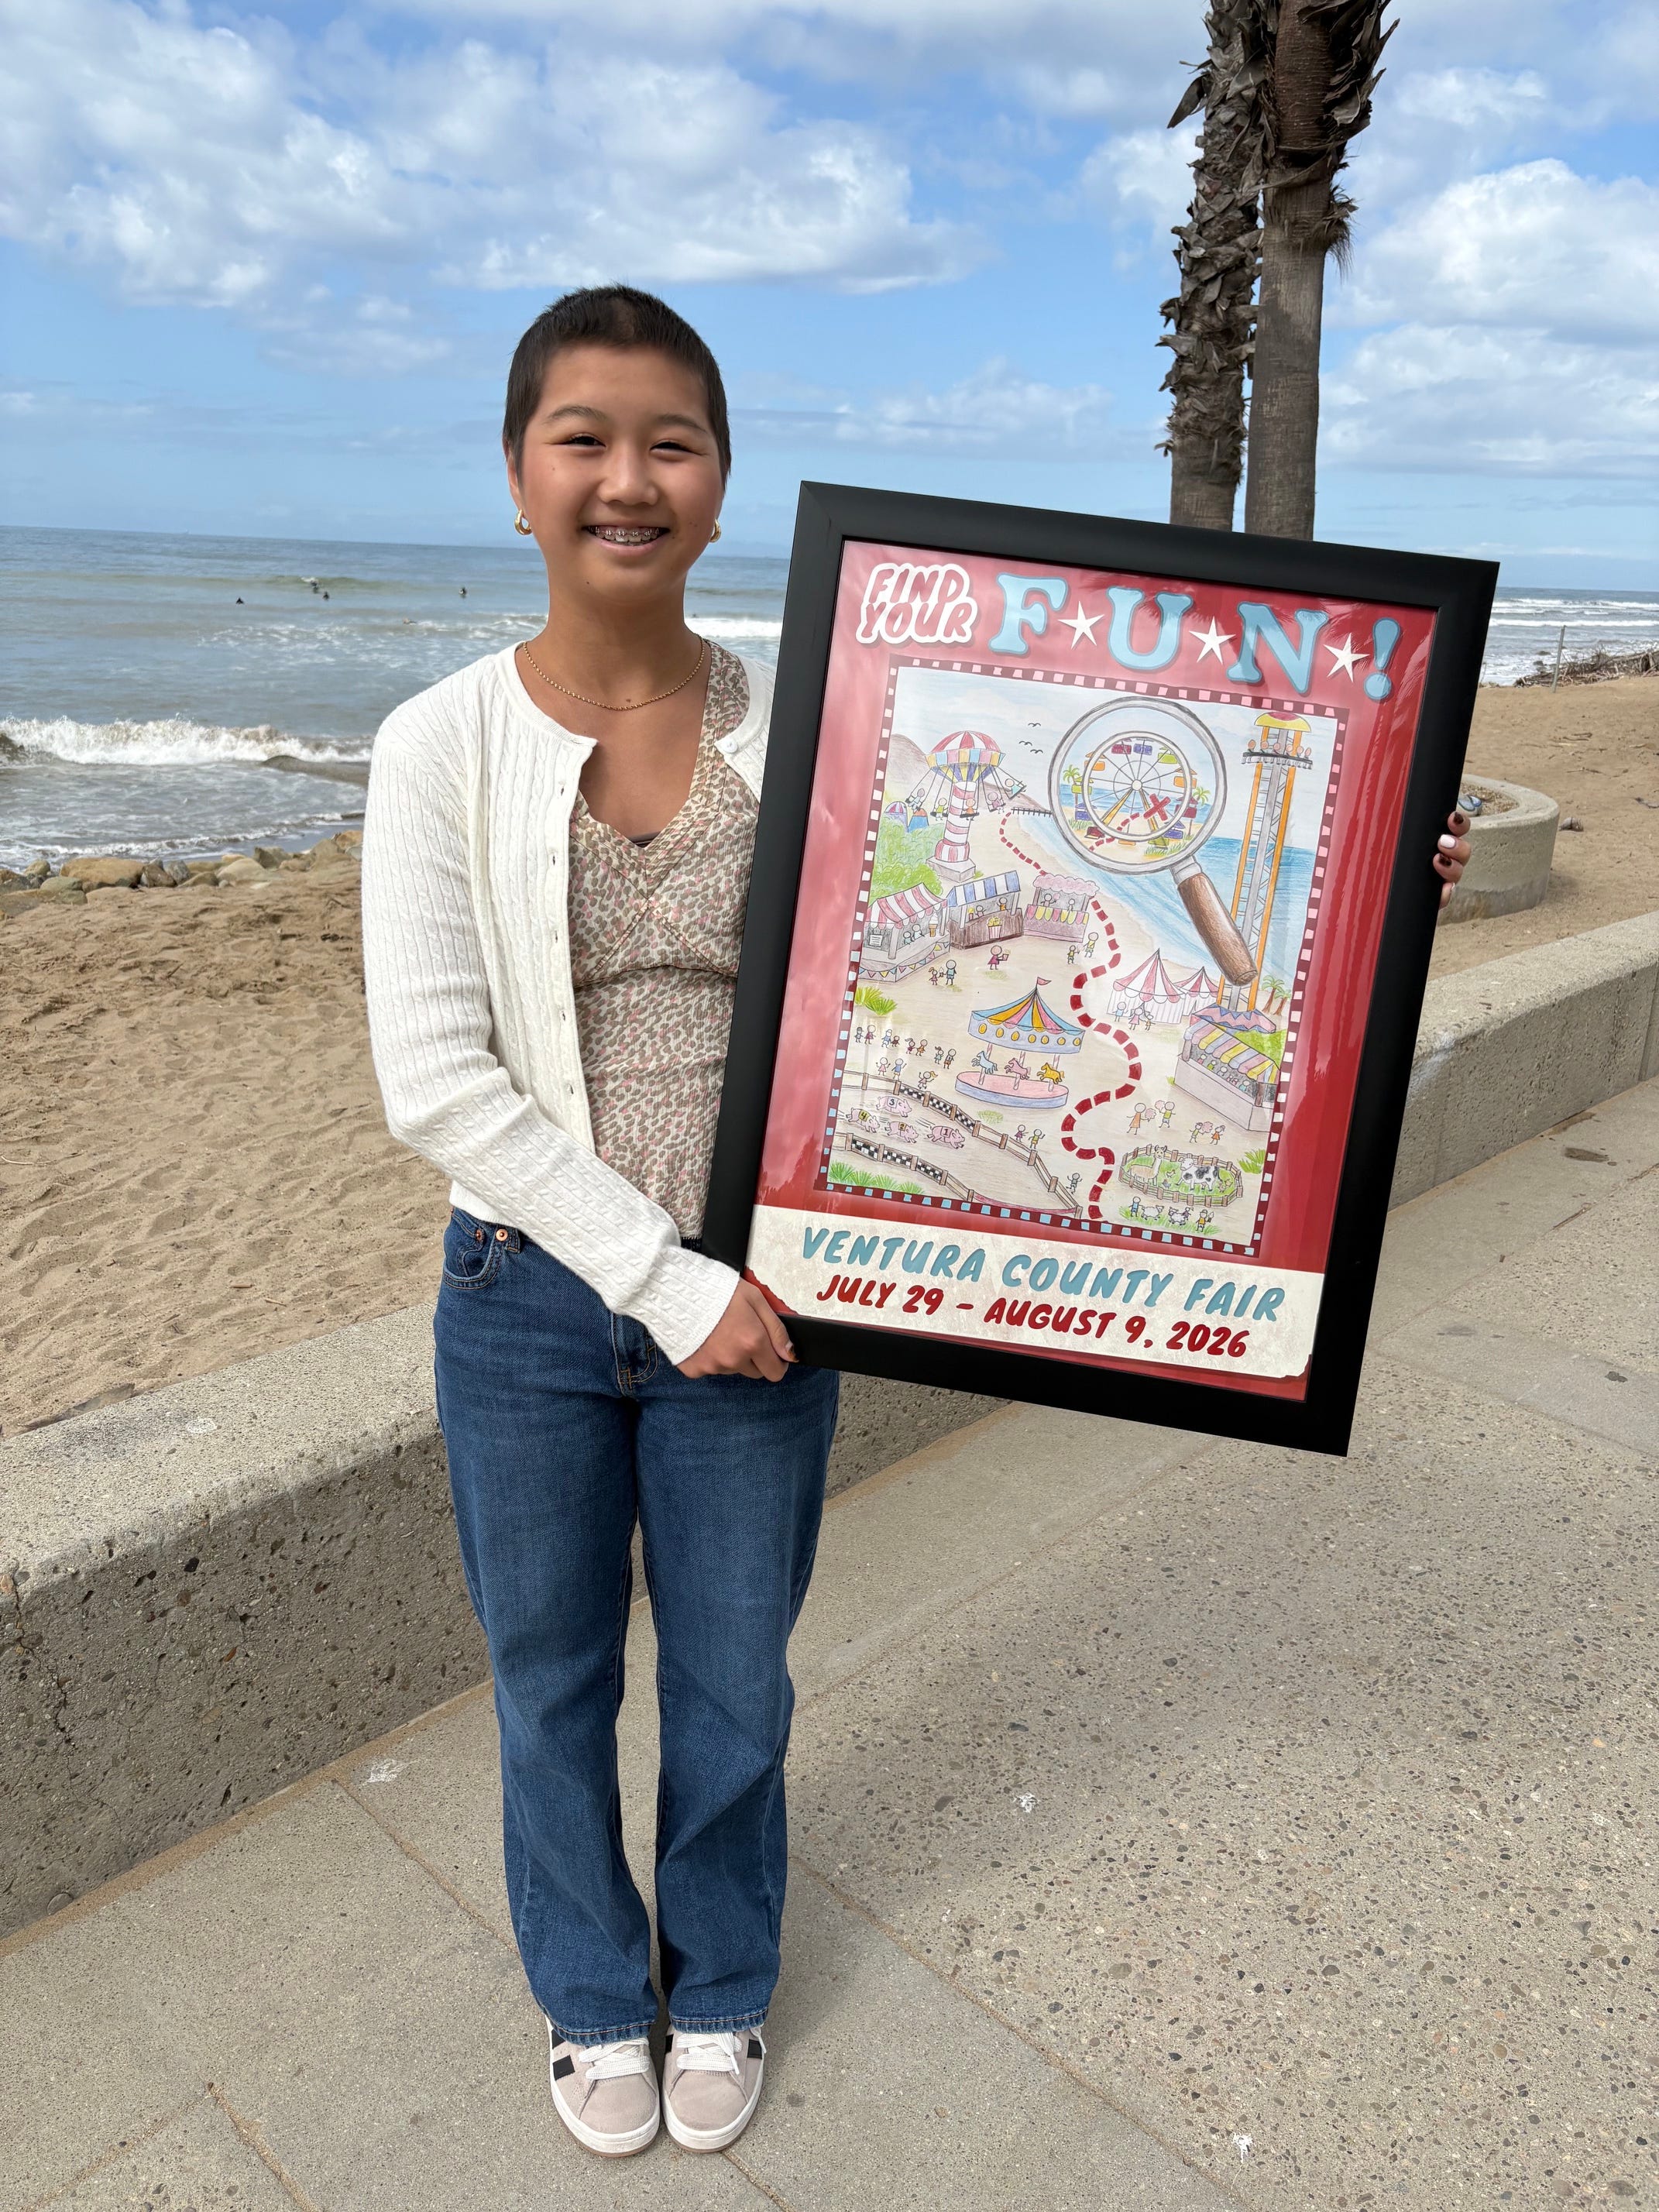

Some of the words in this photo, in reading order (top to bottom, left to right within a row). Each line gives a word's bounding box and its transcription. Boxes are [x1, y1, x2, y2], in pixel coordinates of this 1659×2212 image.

[865, 564, 969, 604] FIND
[857, 599, 976, 642] YOUR
[802, 1227, 984, 1283] VENTURA
[1001, 1254, 1173, 1308] COUNTY
[1187, 1278, 1286, 1322] FAIR
[816, 1275, 897, 1309] JULY
[902, 1285, 944, 1315] 29
[983, 1297, 1117, 1338] AUGUST
[1125, 1316, 1155, 1348] 9,
[1166, 1321, 1250, 1358] 2026
